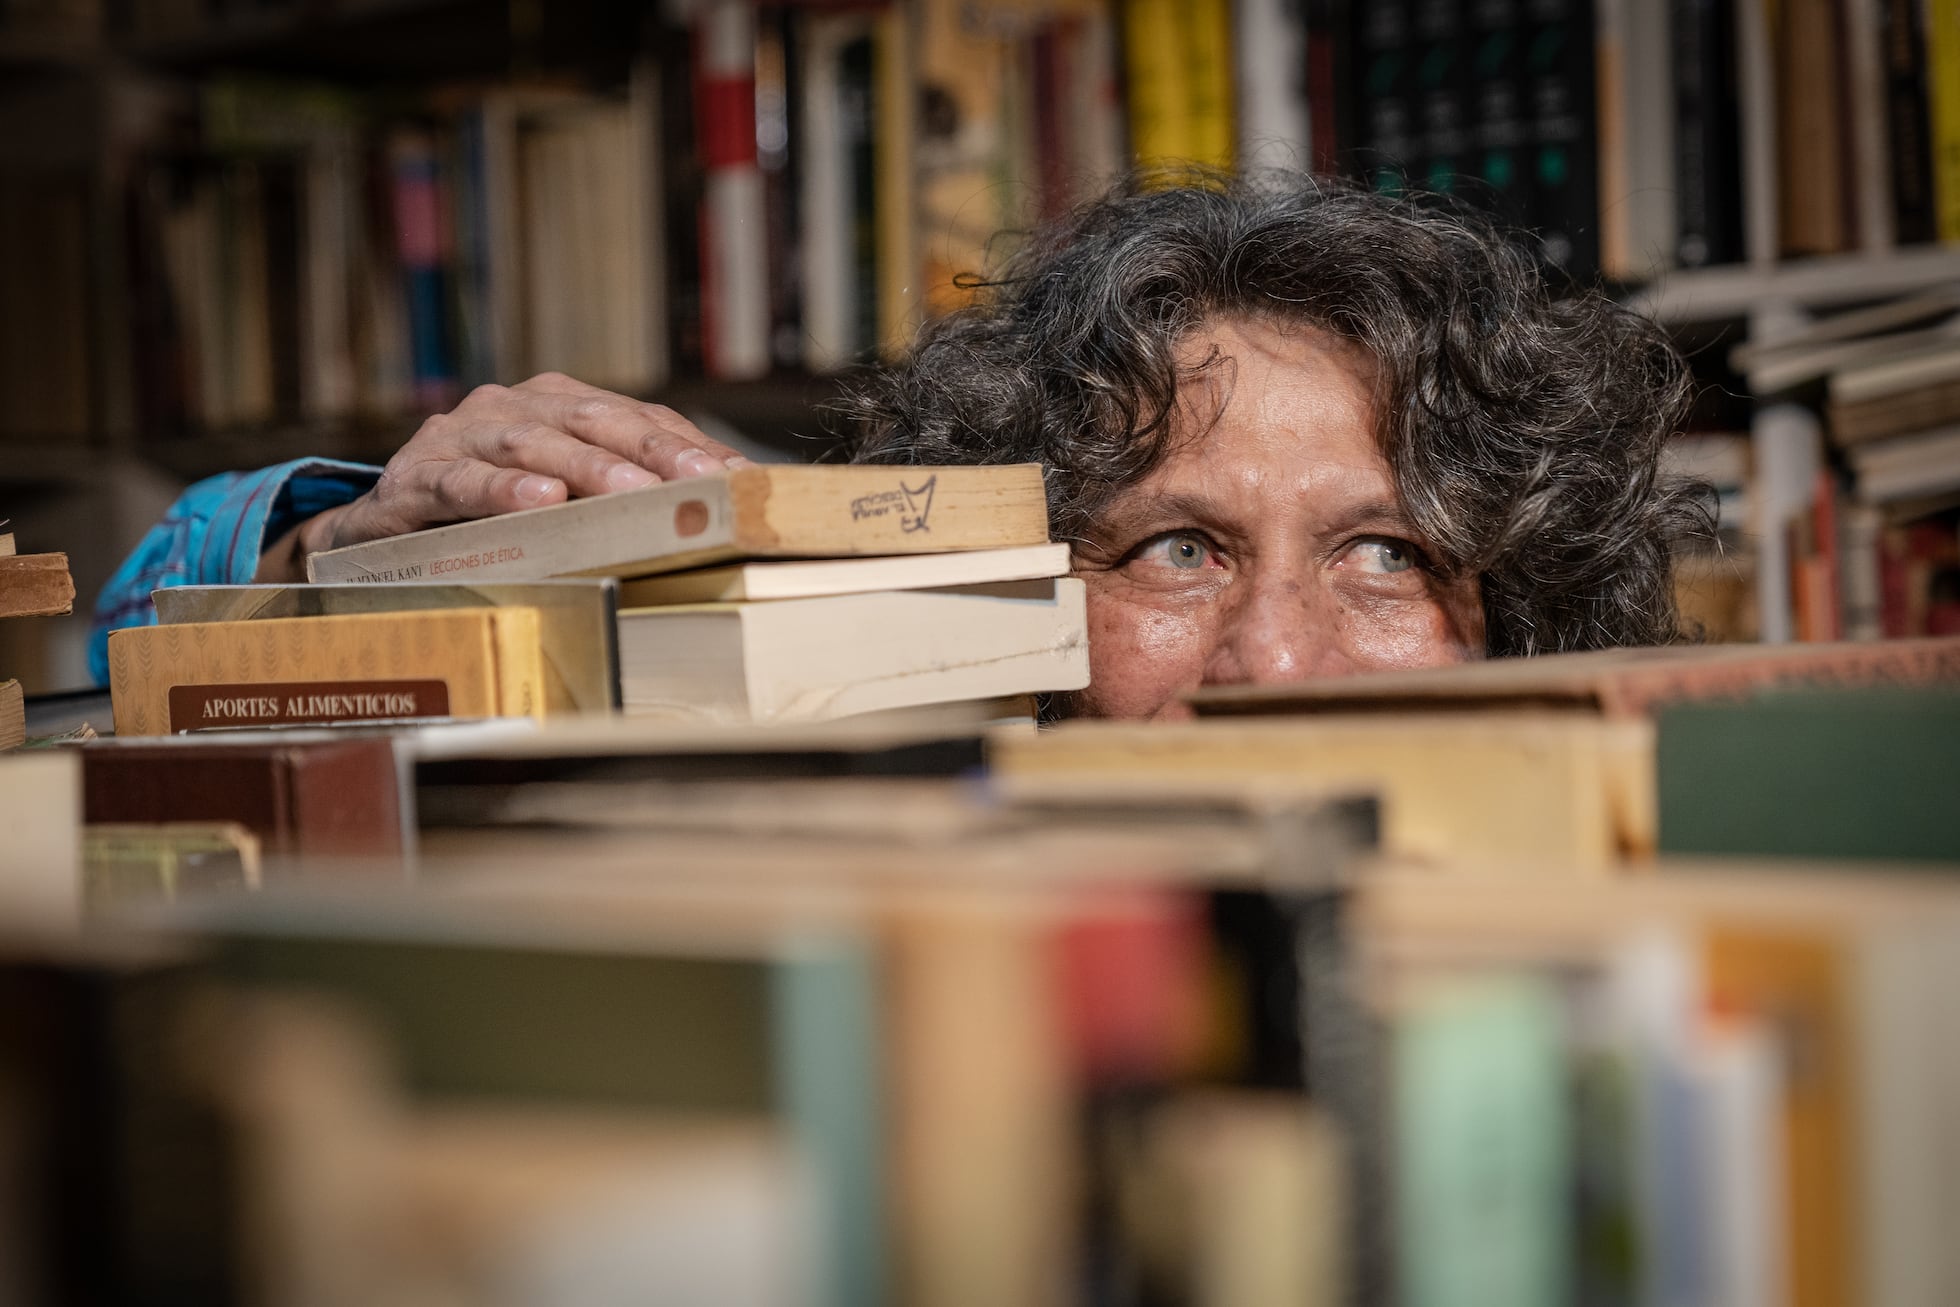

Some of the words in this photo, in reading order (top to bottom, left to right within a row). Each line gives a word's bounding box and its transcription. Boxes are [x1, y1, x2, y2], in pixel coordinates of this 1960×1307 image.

[398, 564, 422, 580] KANT
[430, 554, 480, 575] LECCIONES
[482, 551, 495, 565] DE
[498, 546, 524, 562] ÉTICA
[203, 698, 278, 718] APORTES
[285, 692, 416, 717] ALIMENTICIOS
